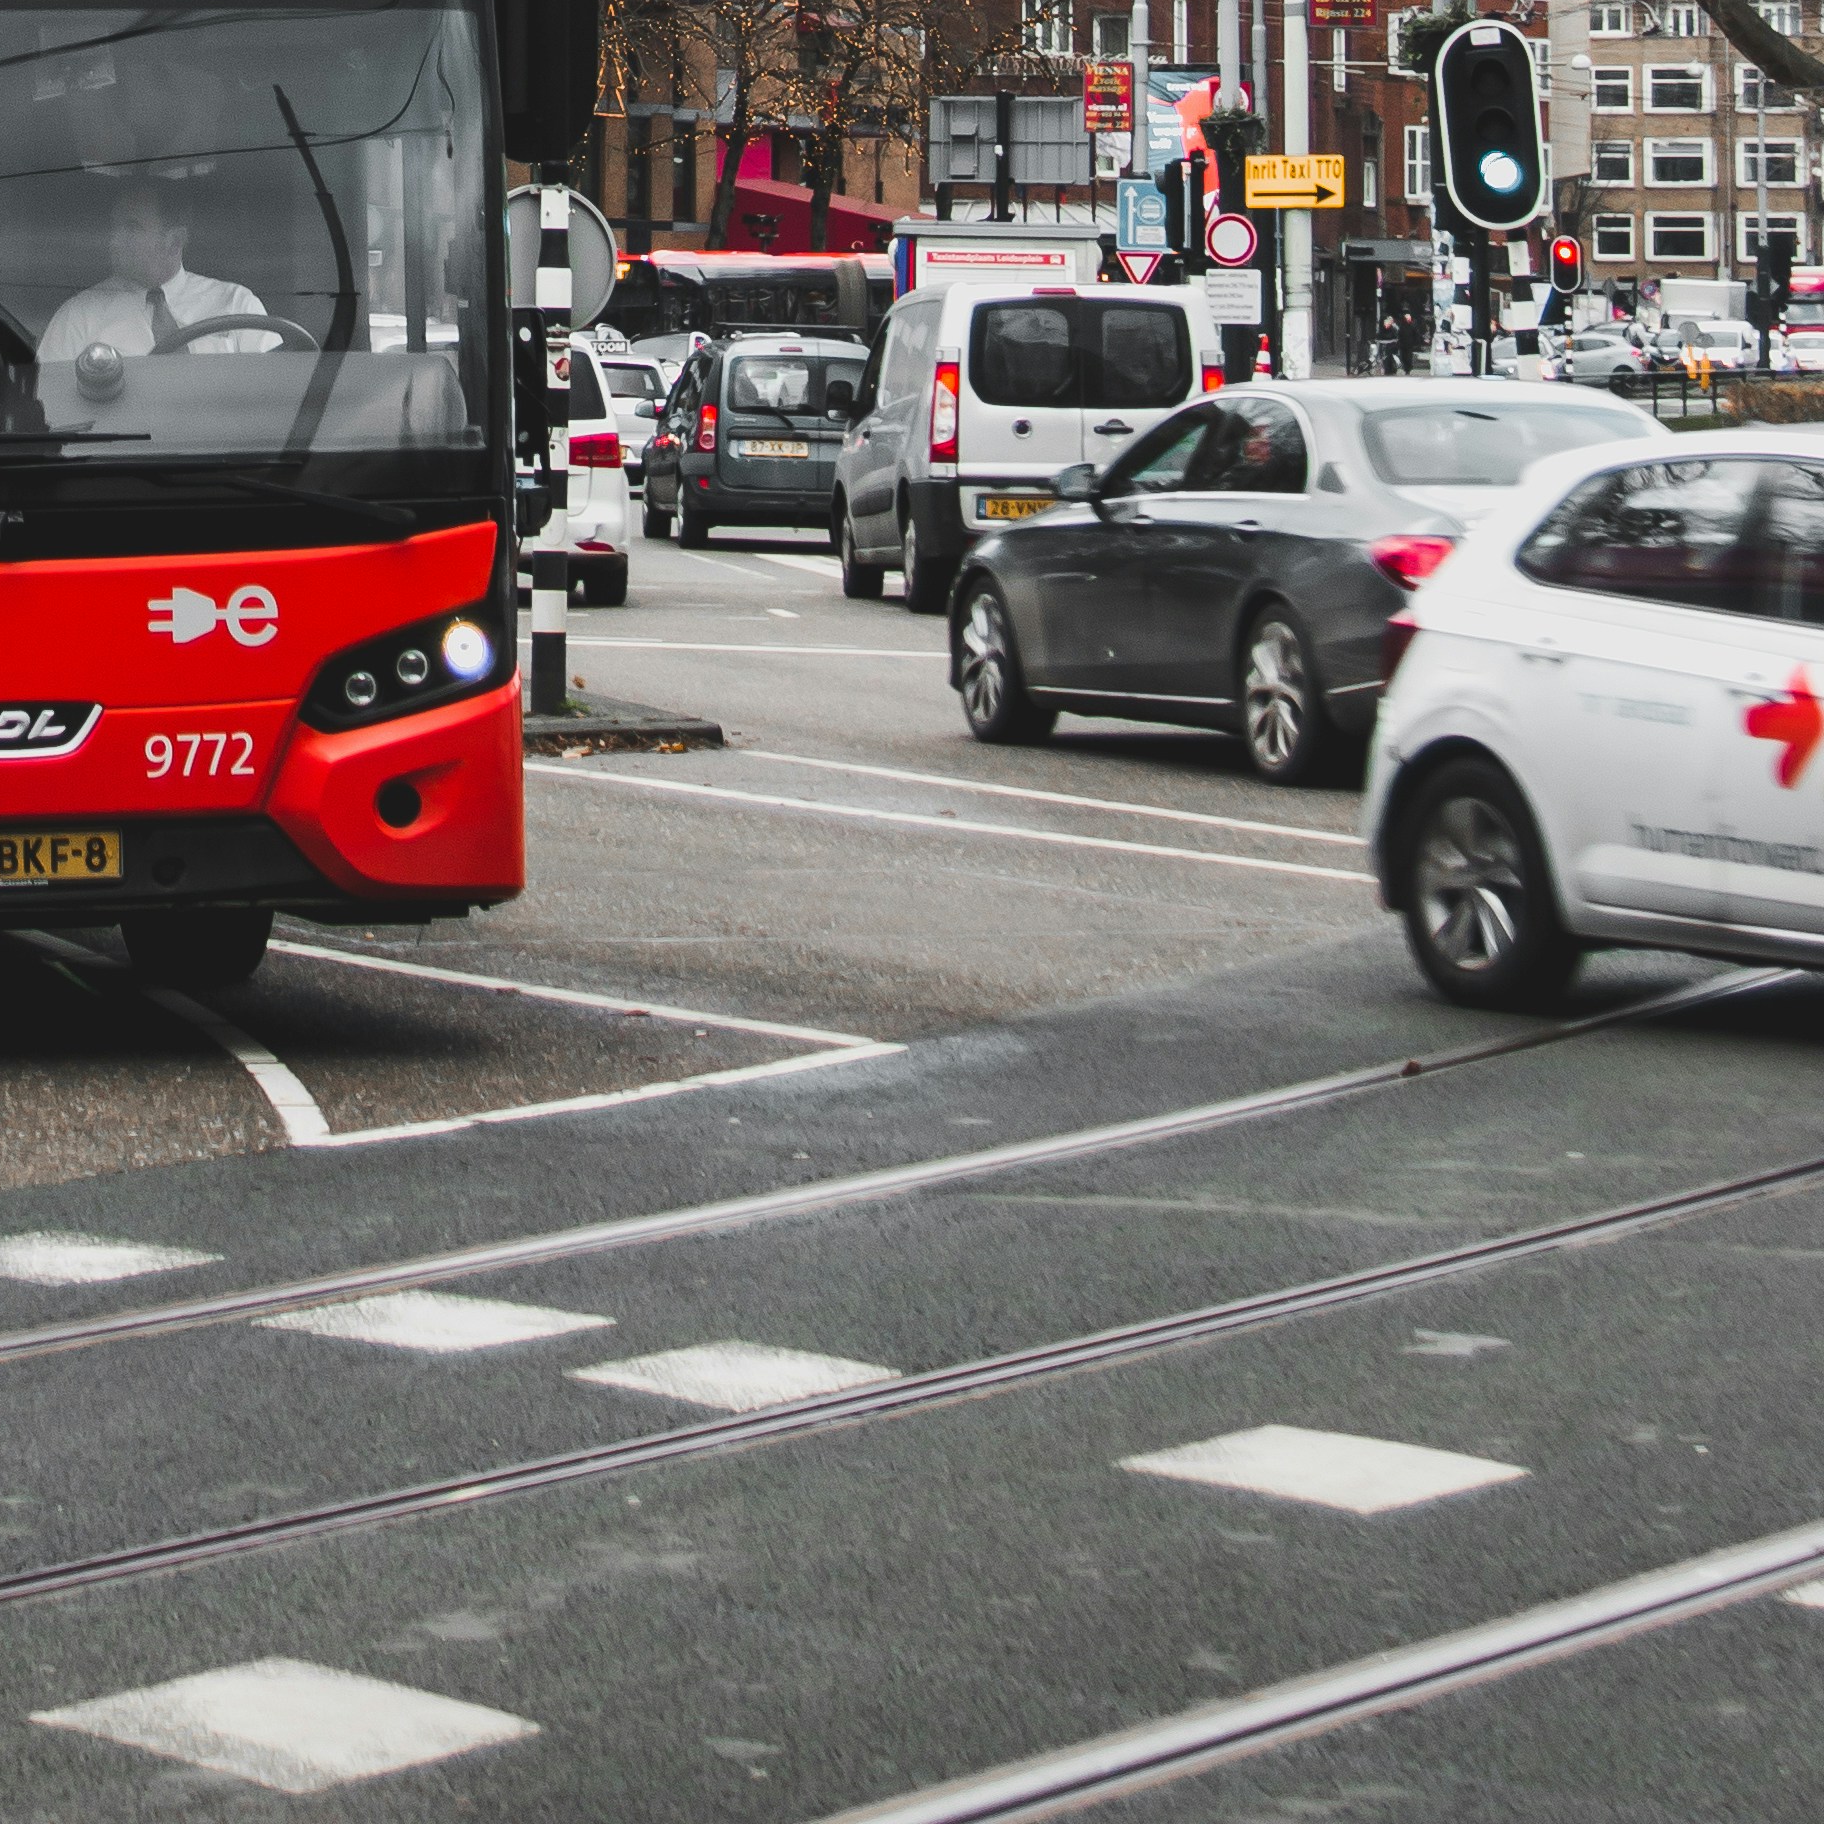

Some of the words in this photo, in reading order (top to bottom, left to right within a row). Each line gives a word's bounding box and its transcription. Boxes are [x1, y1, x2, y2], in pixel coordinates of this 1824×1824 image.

[1246, 159, 1277, 180] Inrit
[1281, 159, 1311, 179] Taxi
[144, 731, 255, 779] 9772
